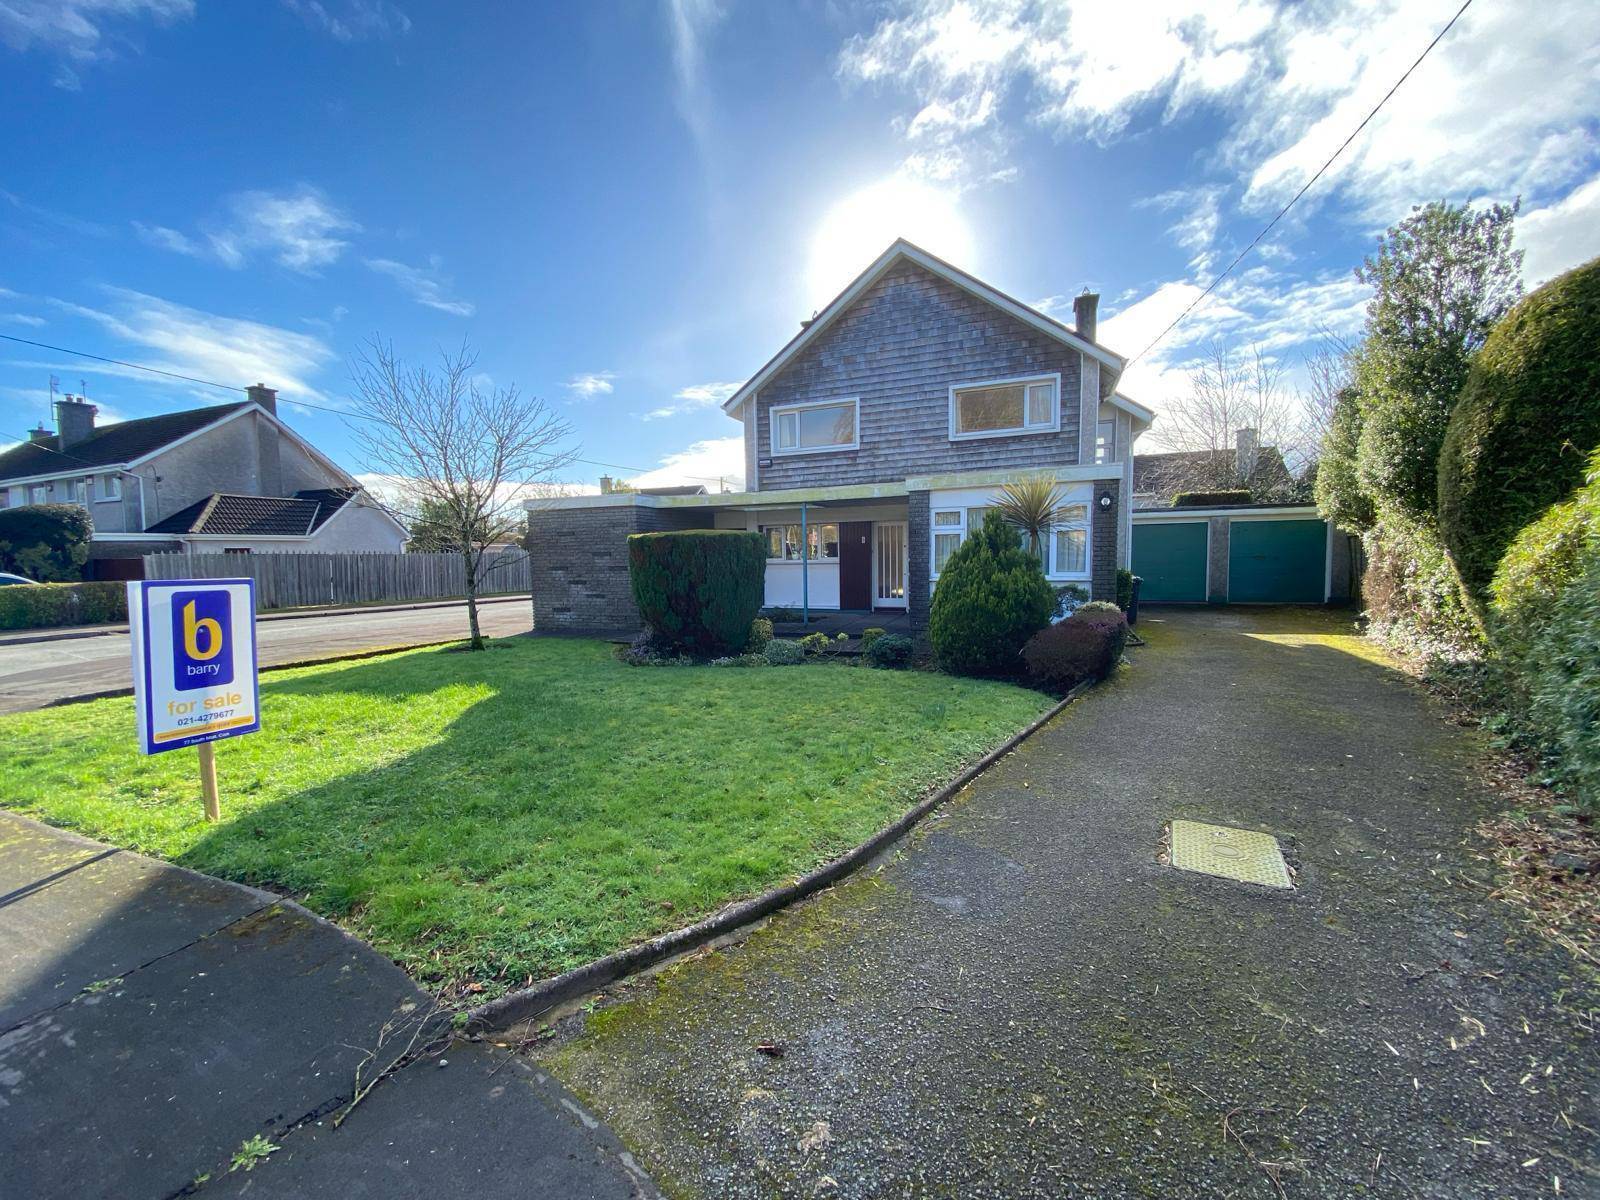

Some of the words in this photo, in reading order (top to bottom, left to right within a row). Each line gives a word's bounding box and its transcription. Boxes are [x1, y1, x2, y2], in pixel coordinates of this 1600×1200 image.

[183, 599, 223, 661] b
[187, 663, 220, 676] barry
[168, 701, 197, 716] for
[204, 693, 242, 709] sale
[177, 710, 234, 726] 021-4279677
